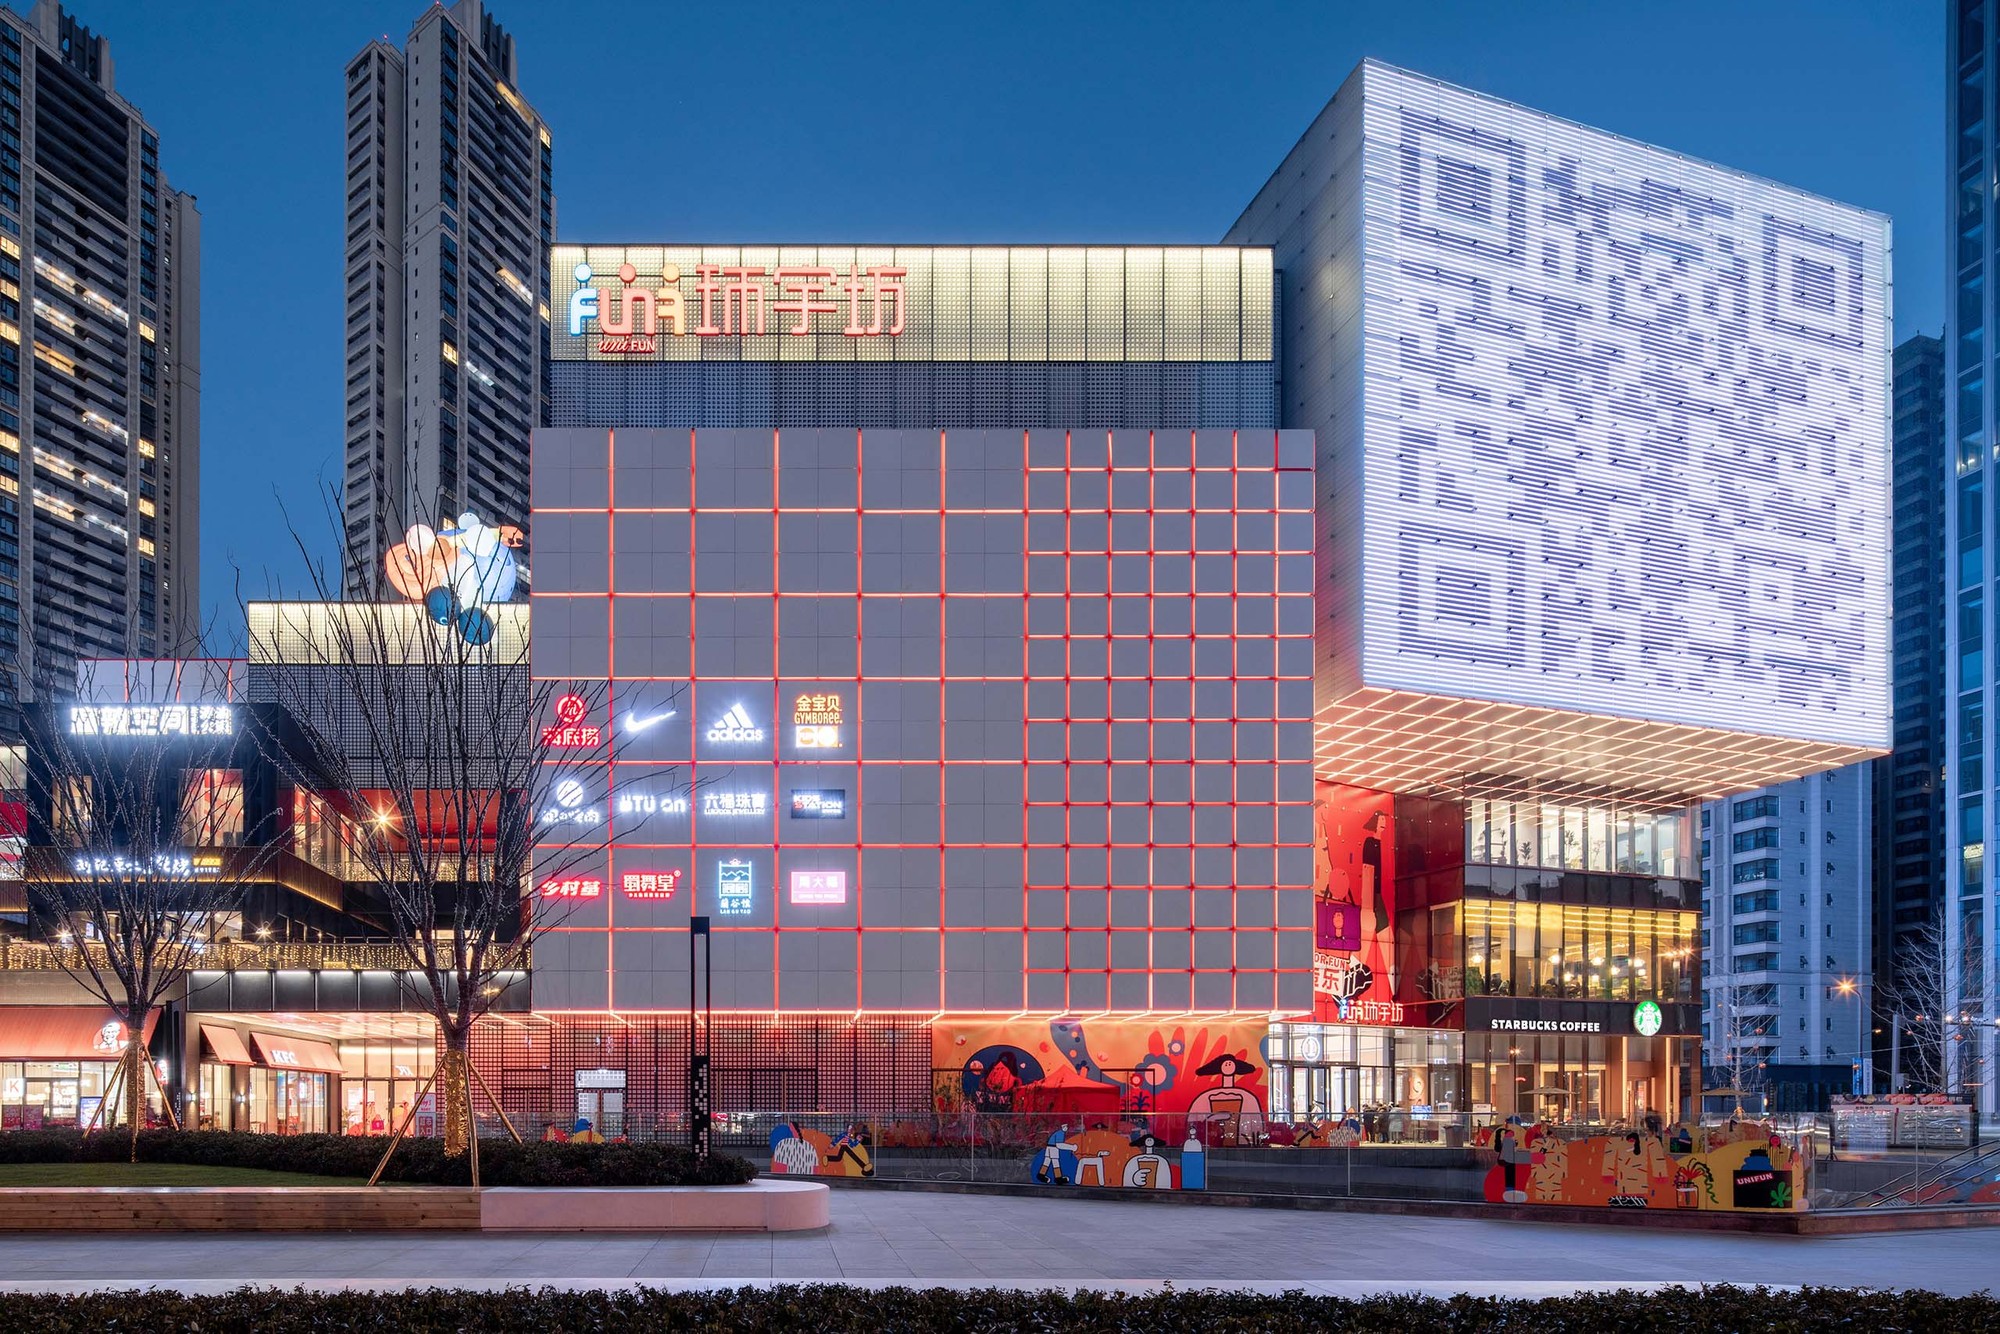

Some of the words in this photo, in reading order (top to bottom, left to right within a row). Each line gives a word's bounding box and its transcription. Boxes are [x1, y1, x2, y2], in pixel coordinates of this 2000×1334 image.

[796, 694, 840, 711] 金宝贝
[707, 726, 763, 742] adidas
[1491, 1019, 1558, 1031] STARBUCKS
[1559, 1021, 1600, 1032] COFFEE
[271, 1050, 298, 1065] KFC
[1737, 1172, 1773, 1185] UNIFUN
